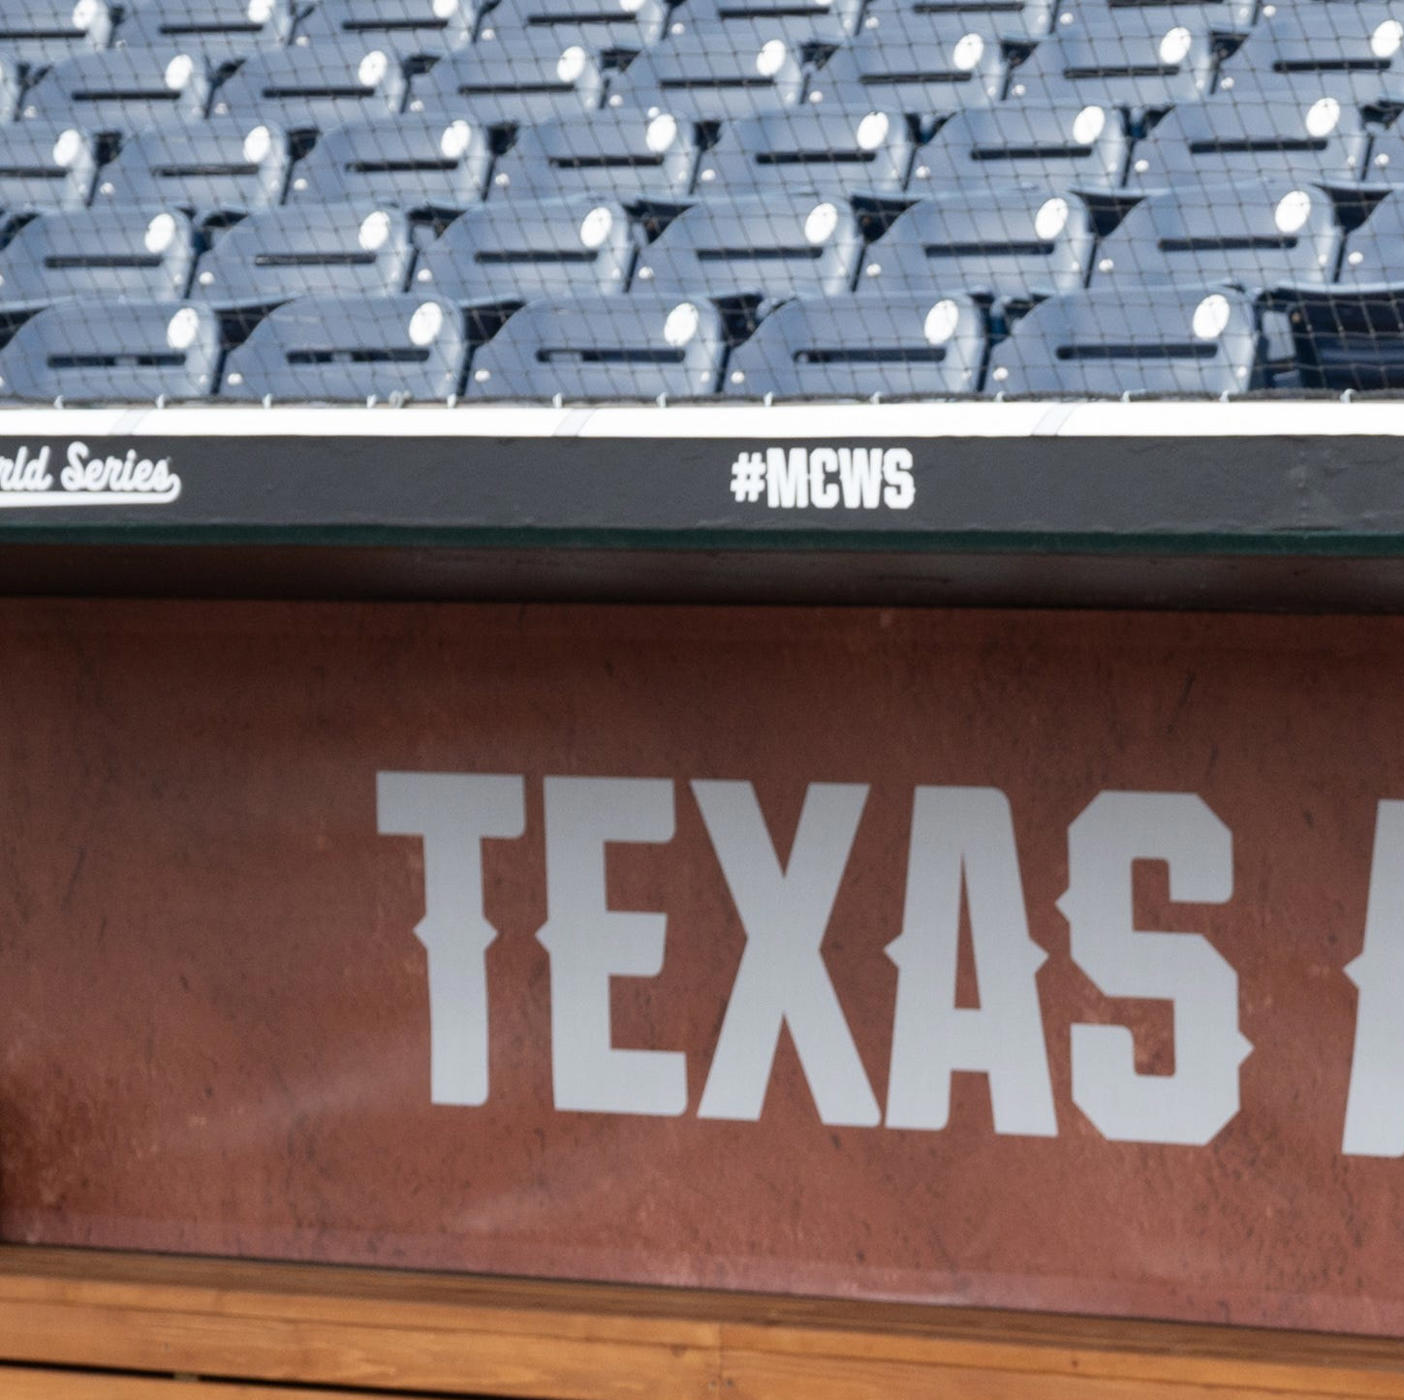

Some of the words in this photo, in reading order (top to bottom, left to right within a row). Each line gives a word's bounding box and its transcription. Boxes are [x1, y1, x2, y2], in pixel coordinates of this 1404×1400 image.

[0, 446, 54, 492] rld
[60, 441, 180, 497] Series
[729, 447, 916, 509] #MCWS
[376, 770, 1255, 1146] TEXAS
